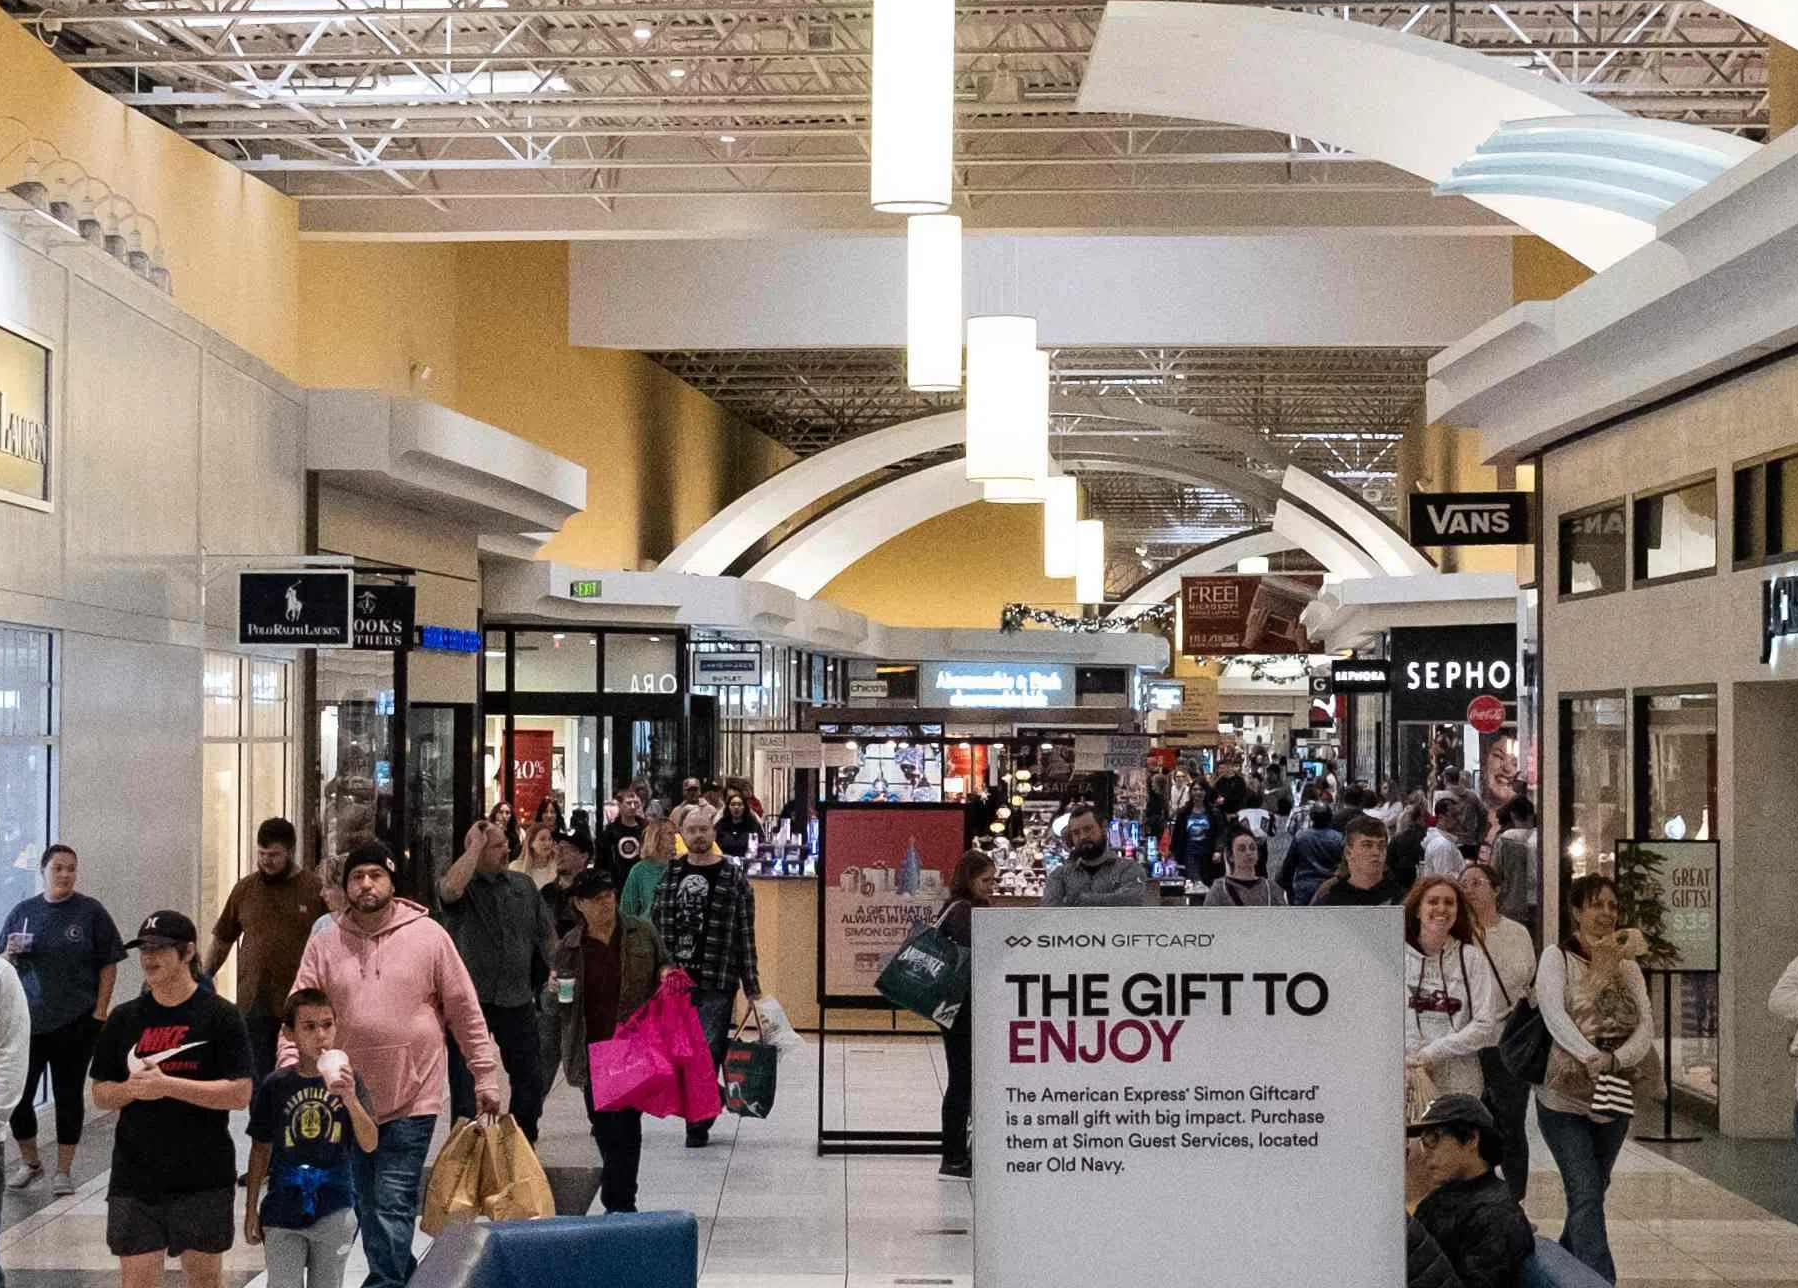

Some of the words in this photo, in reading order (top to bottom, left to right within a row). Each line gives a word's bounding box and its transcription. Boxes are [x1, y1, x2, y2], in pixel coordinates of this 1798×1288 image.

[1427, 503, 1511, 535] VANS
[1188, 585, 1240, 603] FREE!
[354, 619, 403, 634] OOKS
[354, 636, 403, 646] THERS
[1406, 660, 1511, 690] SEPHO
[1671, 867, 1714, 887] GREAT
[1671, 889, 1712, 908] GIFTS!
[841, 914, 886, 924] ALWAYS
[887, 914, 900, 924] IN
[902, 914, 940, 924] FASHIO
[866, 906, 889, 914] GIFT
[890, 906, 921, 914] THAT
[844, 927, 881, 937] SIMON
[883, 927, 909, 937] GIFT
[1037, 934, 1106, 948] SIMON
[1005, 972, 1110, 1017] THE
[1121, 972, 1244, 1017] GIFT
[1253, 971, 1329, 1017] TO
[1008, 1019, 1185, 1063] ENJOY
[1006, 1087, 1037, 1102] The
[1041, 1087, 1119, 1102] American
[1194, 1086, 1245, 1101] Simon
[1006, 1110, 1019, 1126] is
[1023, 1114, 1032, 1126] a
[1036, 1110, 1079, 1126] small
[1083, 1110, 1111, 1129] gift
[1115, 1109, 1151, 1125] with
[1155, 1109, 1181, 1128] big
[1185, 1109, 1245, 1128] impact.
[1251, 1108, 1325, 1124] Purchase
[1006, 1134, 1048, 1149] them
[1053, 1135, 1068, 1149] at
[1072, 1133, 1124, 1149] Simon
[1129, 1133, 1176, 1149] Guest
[1181, 1132, 1254, 1150] Services,
[1258, 1131, 1319, 1147] located
[1006, 1159, 1043, 1173] near
[1046, 1157, 1076, 1172] Old
[1081, 1157, 1125, 1177] Navy.
